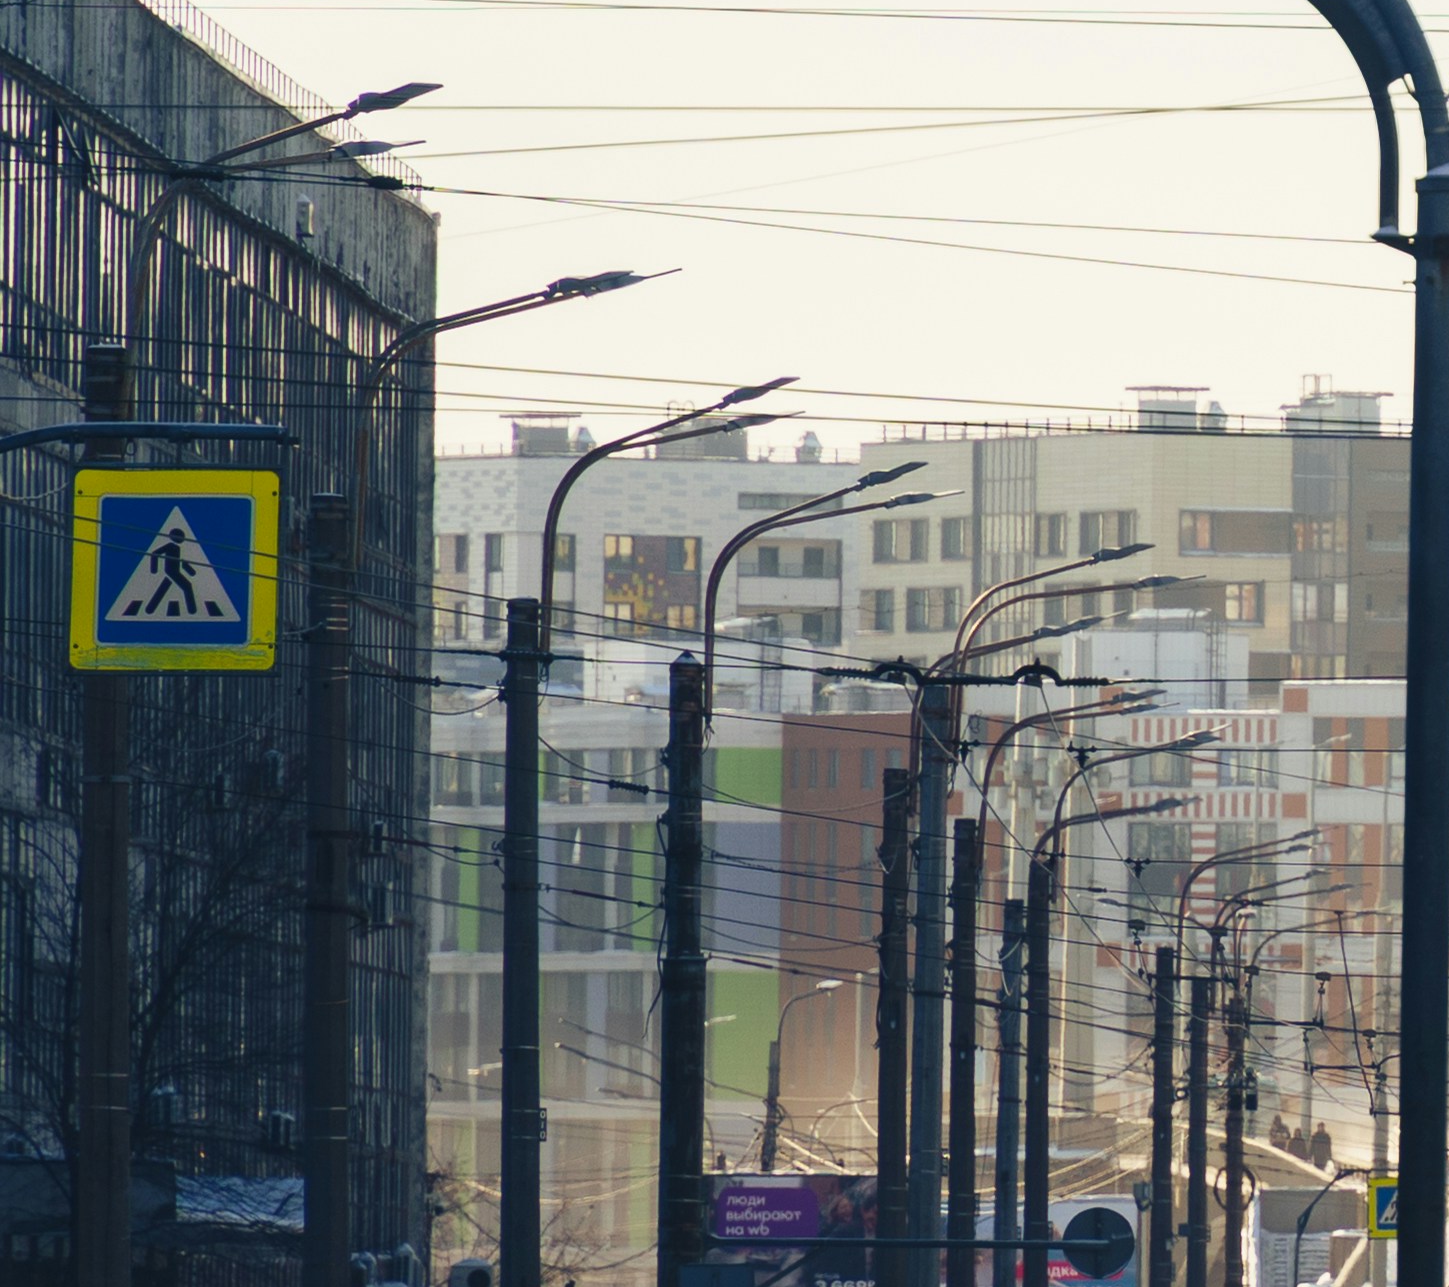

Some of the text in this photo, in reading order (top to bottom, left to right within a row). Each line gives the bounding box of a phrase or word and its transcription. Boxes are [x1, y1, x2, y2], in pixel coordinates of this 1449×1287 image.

[727, 1196, 766, 1206] люди
[726, 1208, 802, 1224] выбирают
[726, 1224, 770, 1236] на wb
